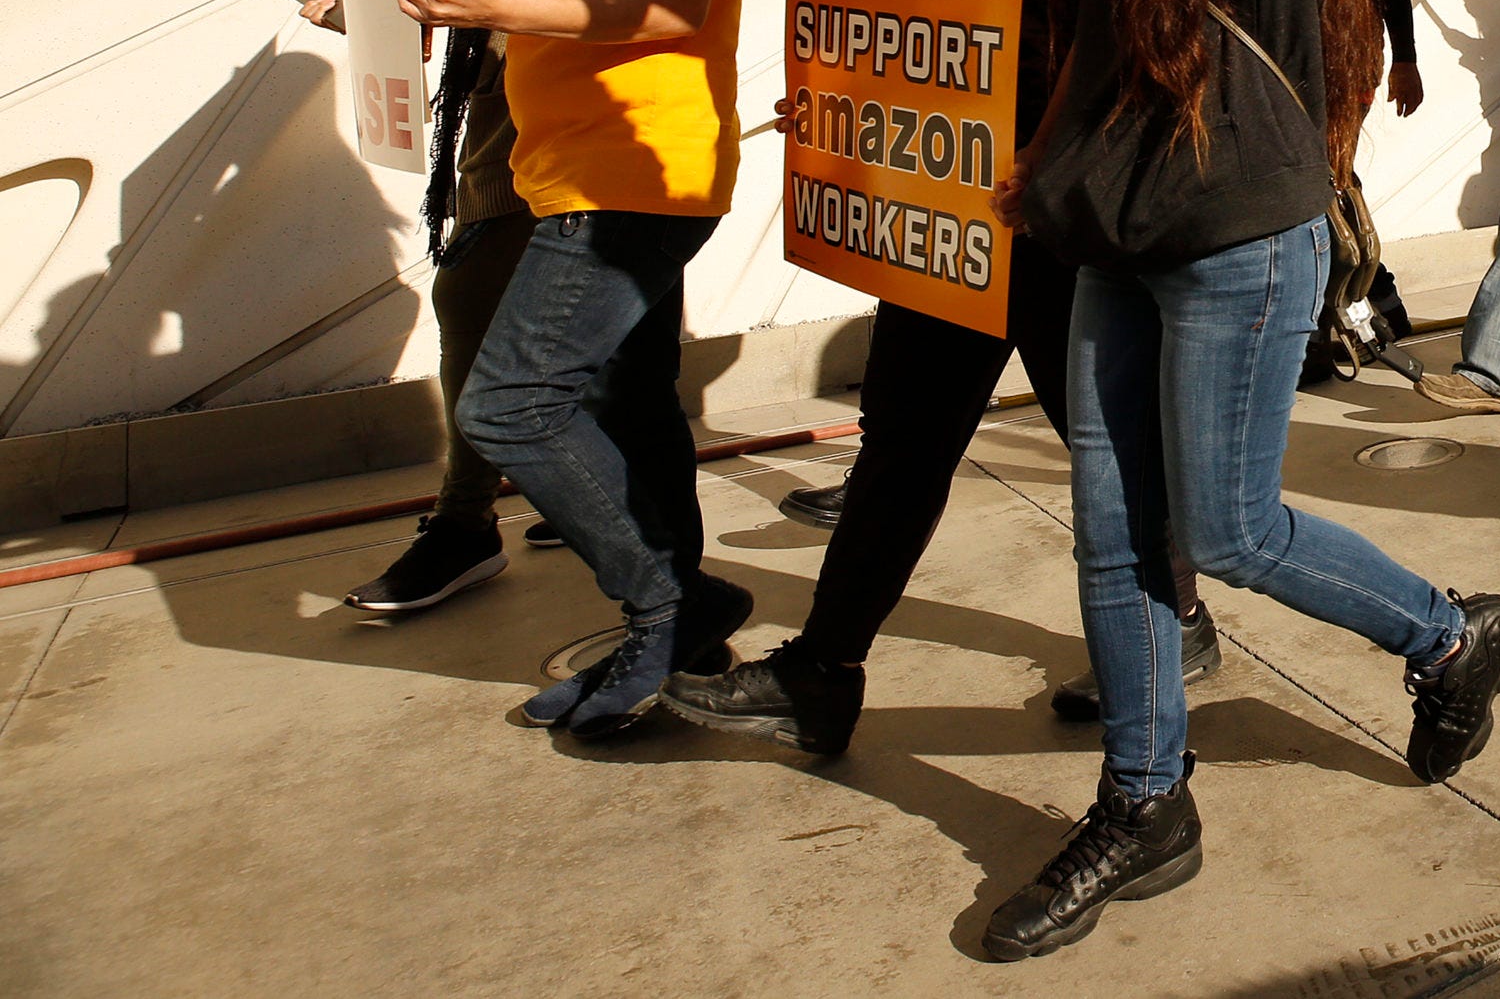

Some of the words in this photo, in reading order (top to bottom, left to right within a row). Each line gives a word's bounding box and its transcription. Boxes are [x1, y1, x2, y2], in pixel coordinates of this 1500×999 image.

[794, 1, 1004, 95] SUPPORT
[359, 73, 413, 150] SE
[794, 86, 994, 191] amazon
[791, 171, 994, 292] WORKERS
